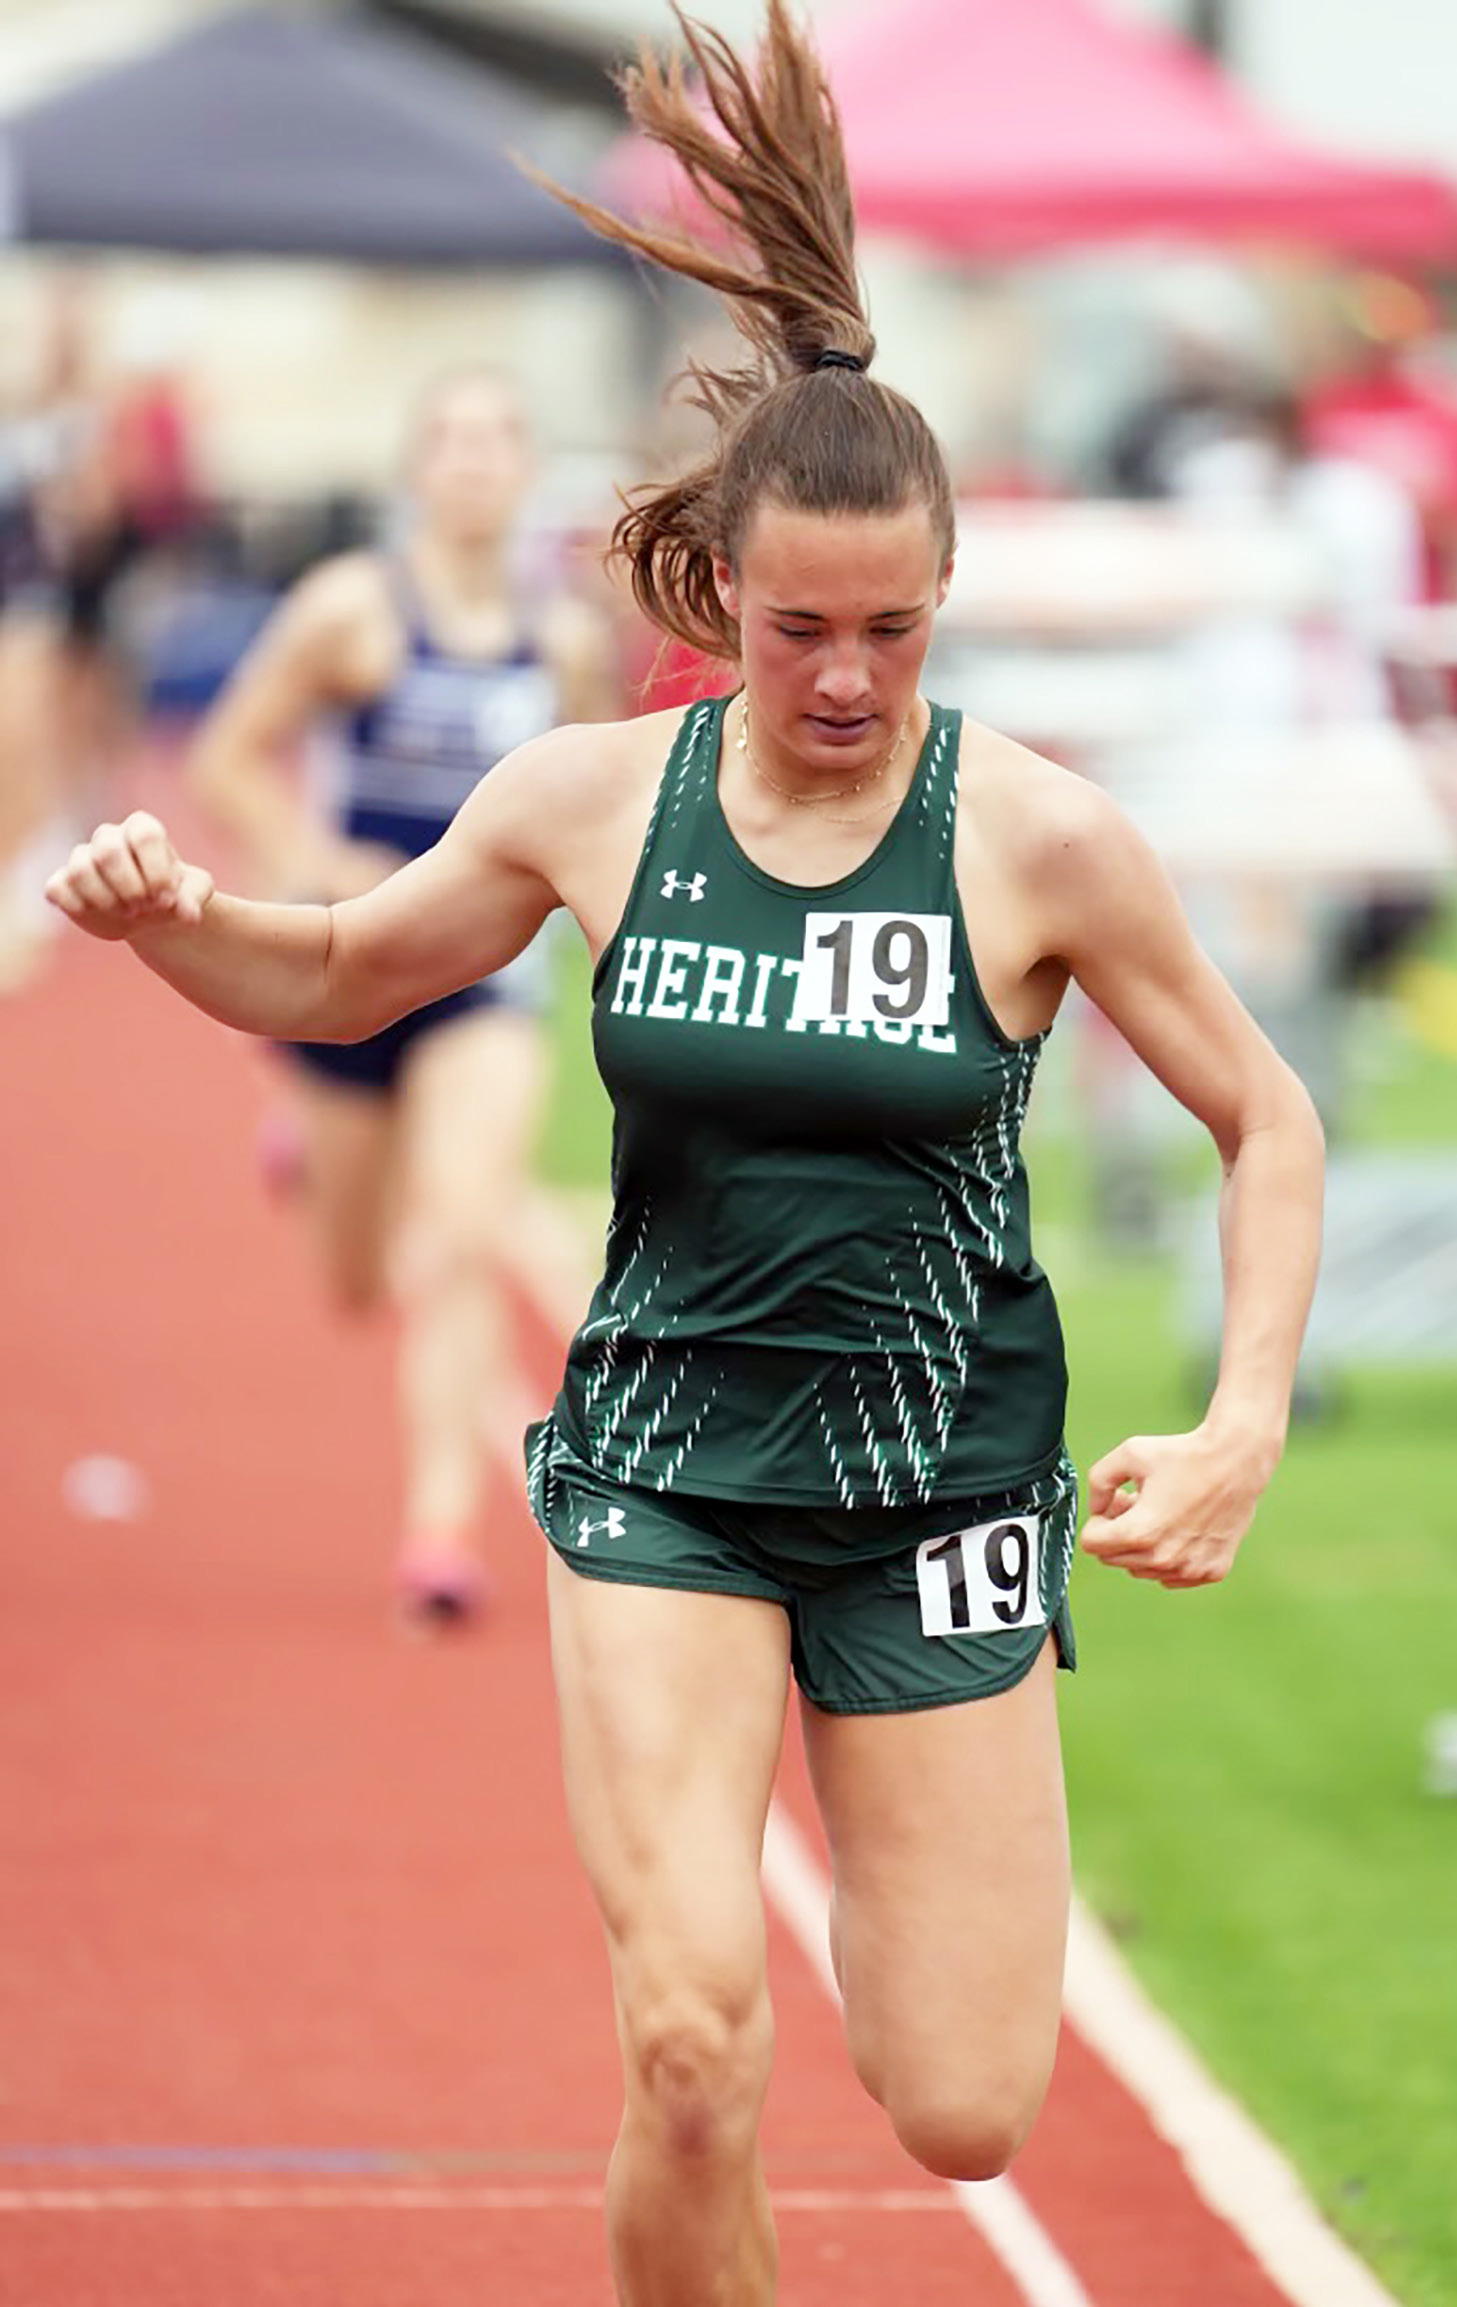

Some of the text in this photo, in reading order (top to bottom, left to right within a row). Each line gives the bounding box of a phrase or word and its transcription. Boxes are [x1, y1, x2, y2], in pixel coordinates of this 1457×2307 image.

[610, 937, 957, 1053] HERIT
[816, 920, 929, 1019] 19
[926, 1523, 1029, 1628] 19
